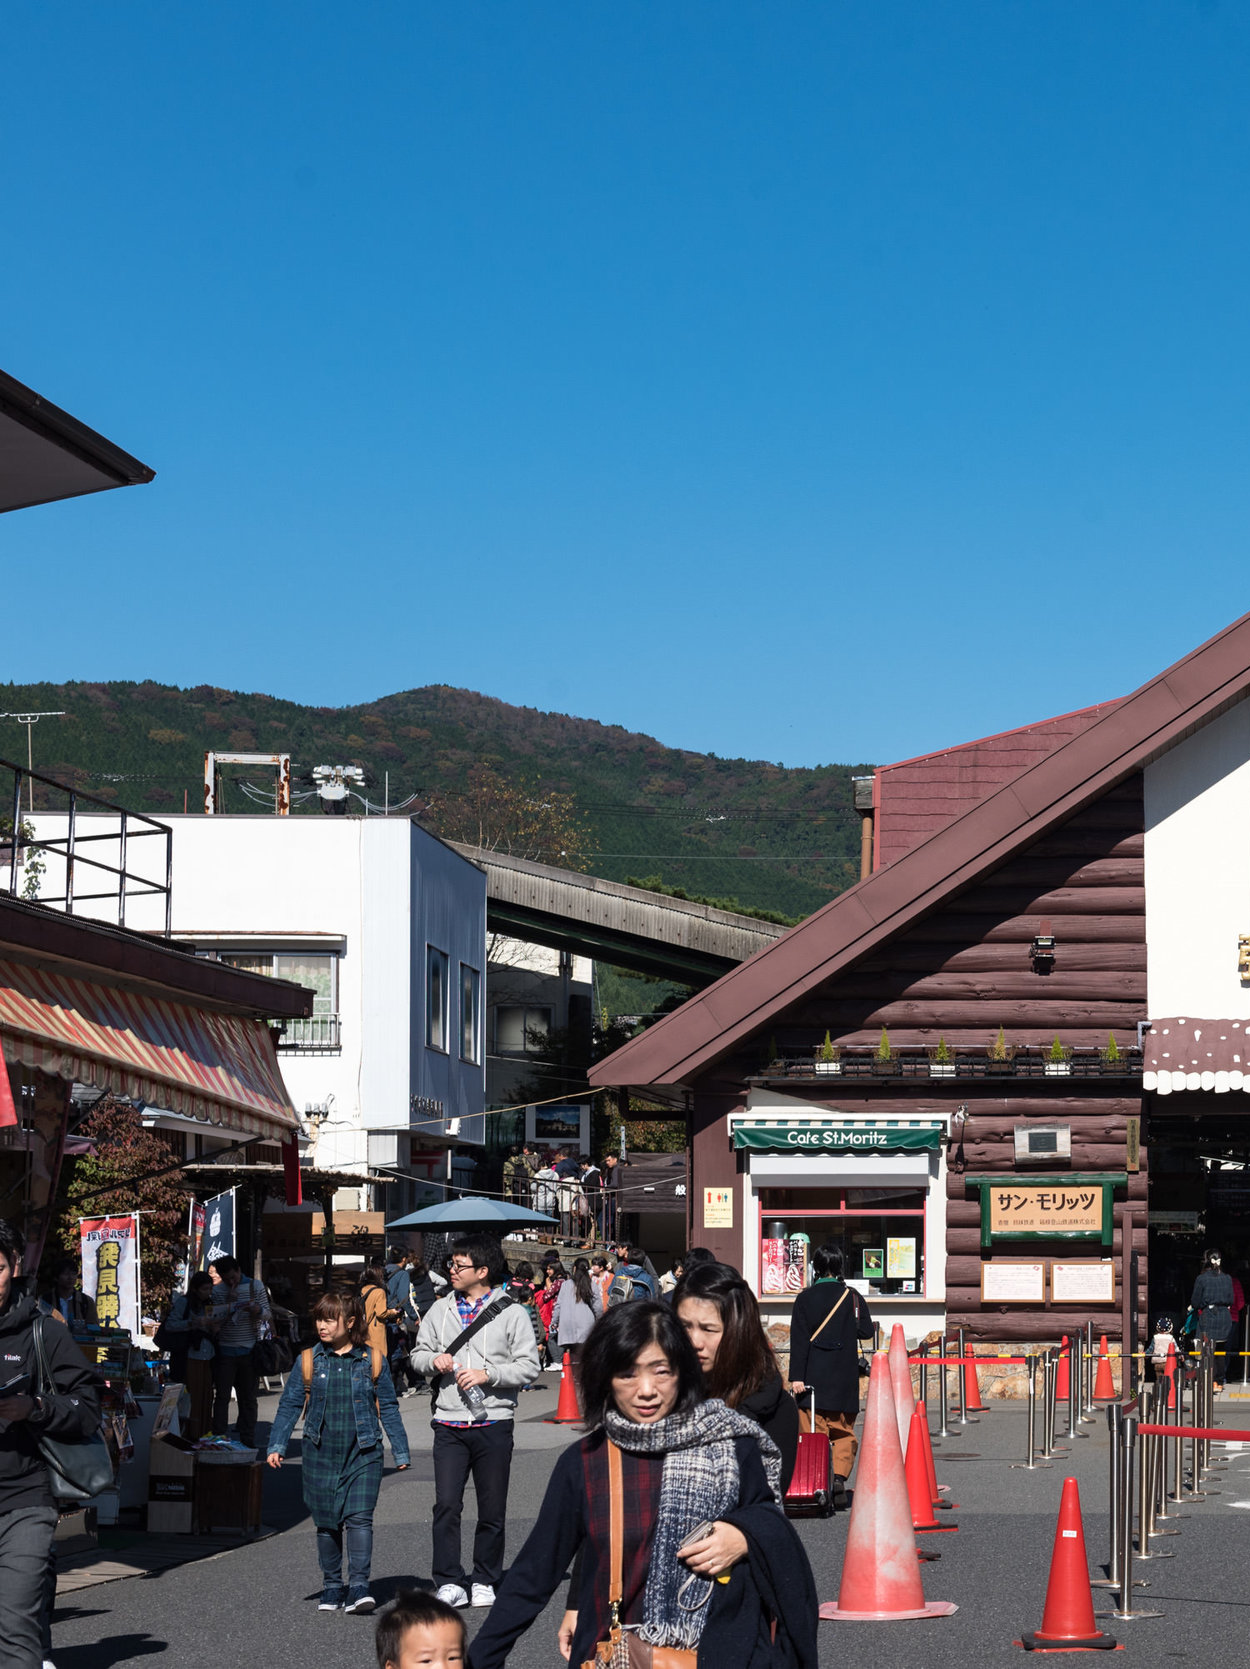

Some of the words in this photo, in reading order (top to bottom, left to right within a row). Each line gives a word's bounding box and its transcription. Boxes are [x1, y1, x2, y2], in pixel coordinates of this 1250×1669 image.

[998, 1193, 1095, 1211] サン・モリッツ
